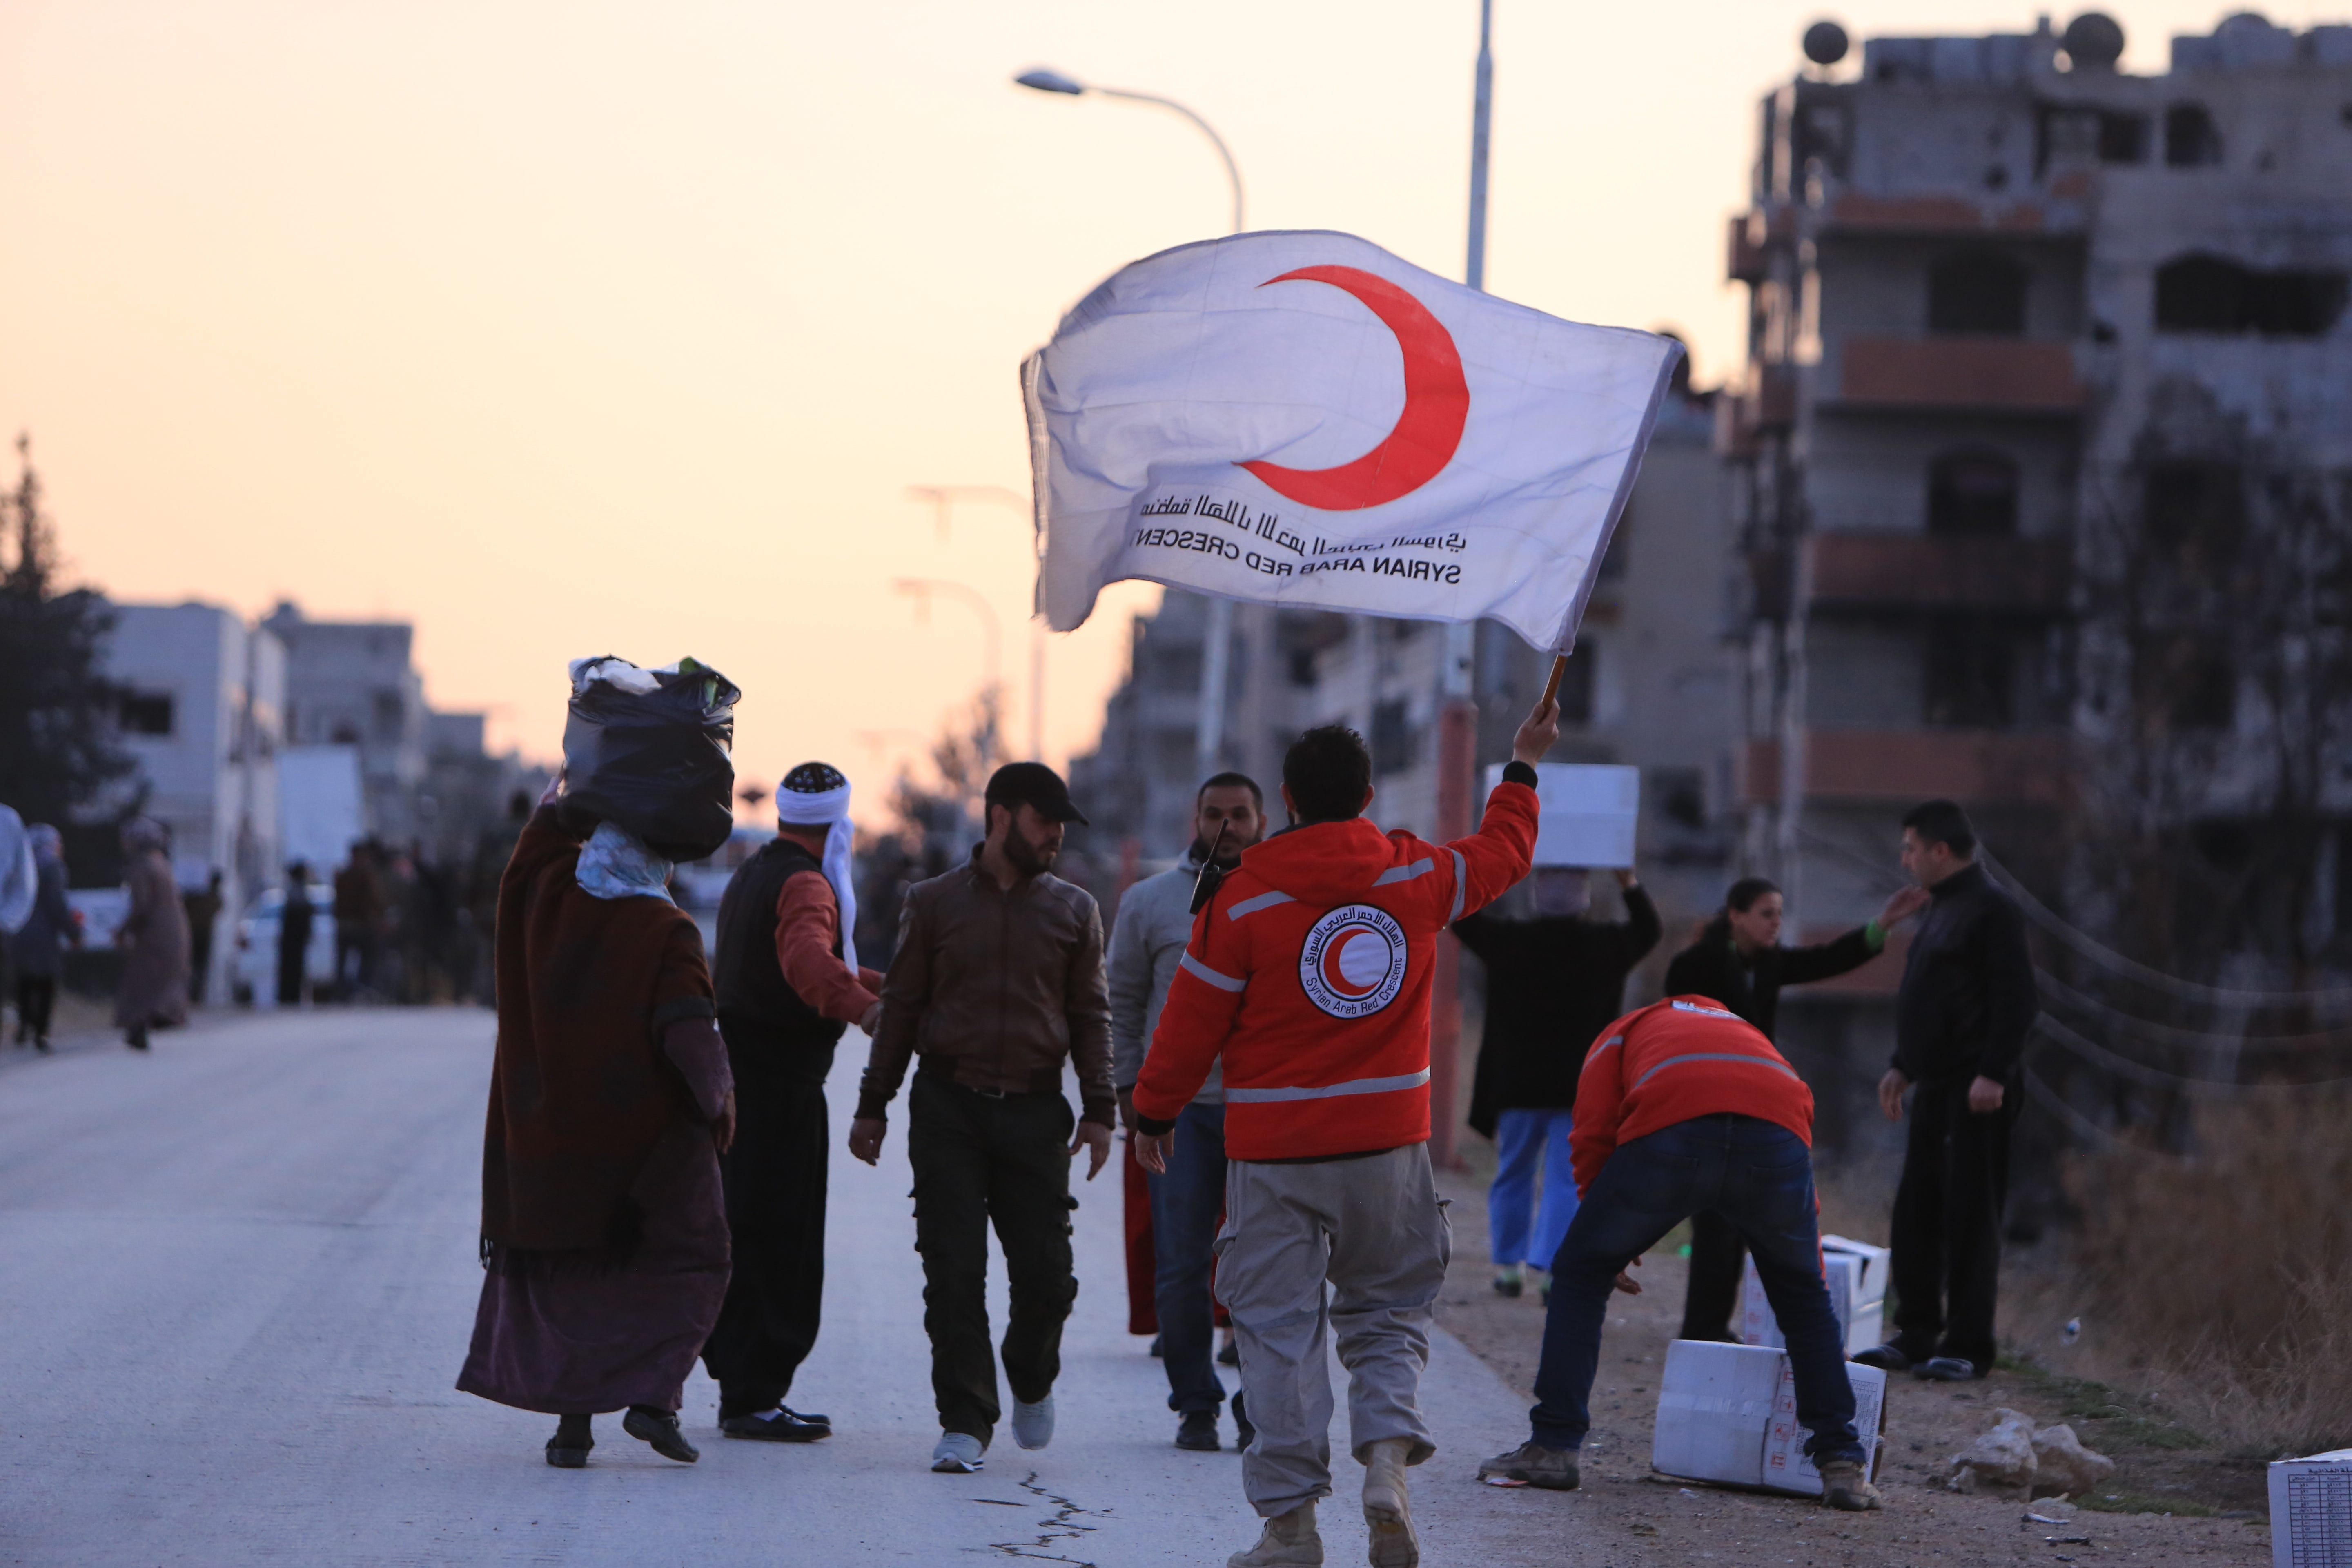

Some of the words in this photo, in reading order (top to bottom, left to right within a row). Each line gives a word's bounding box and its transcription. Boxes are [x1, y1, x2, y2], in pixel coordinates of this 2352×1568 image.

[1324, 907, 1356, 932] العربي
[1356, 910, 1385, 926] الأحمر
[1305, 927, 1325, 966] السوري
[1383, 921, 1404, 948] الهلال
[1306, 977, 1331, 1007] Syrian
[1332, 1001, 1357, 1015] Arab
[1361, 998, 1379, 1013] Red
[1379, 958, 1403, 1002] Crescent
